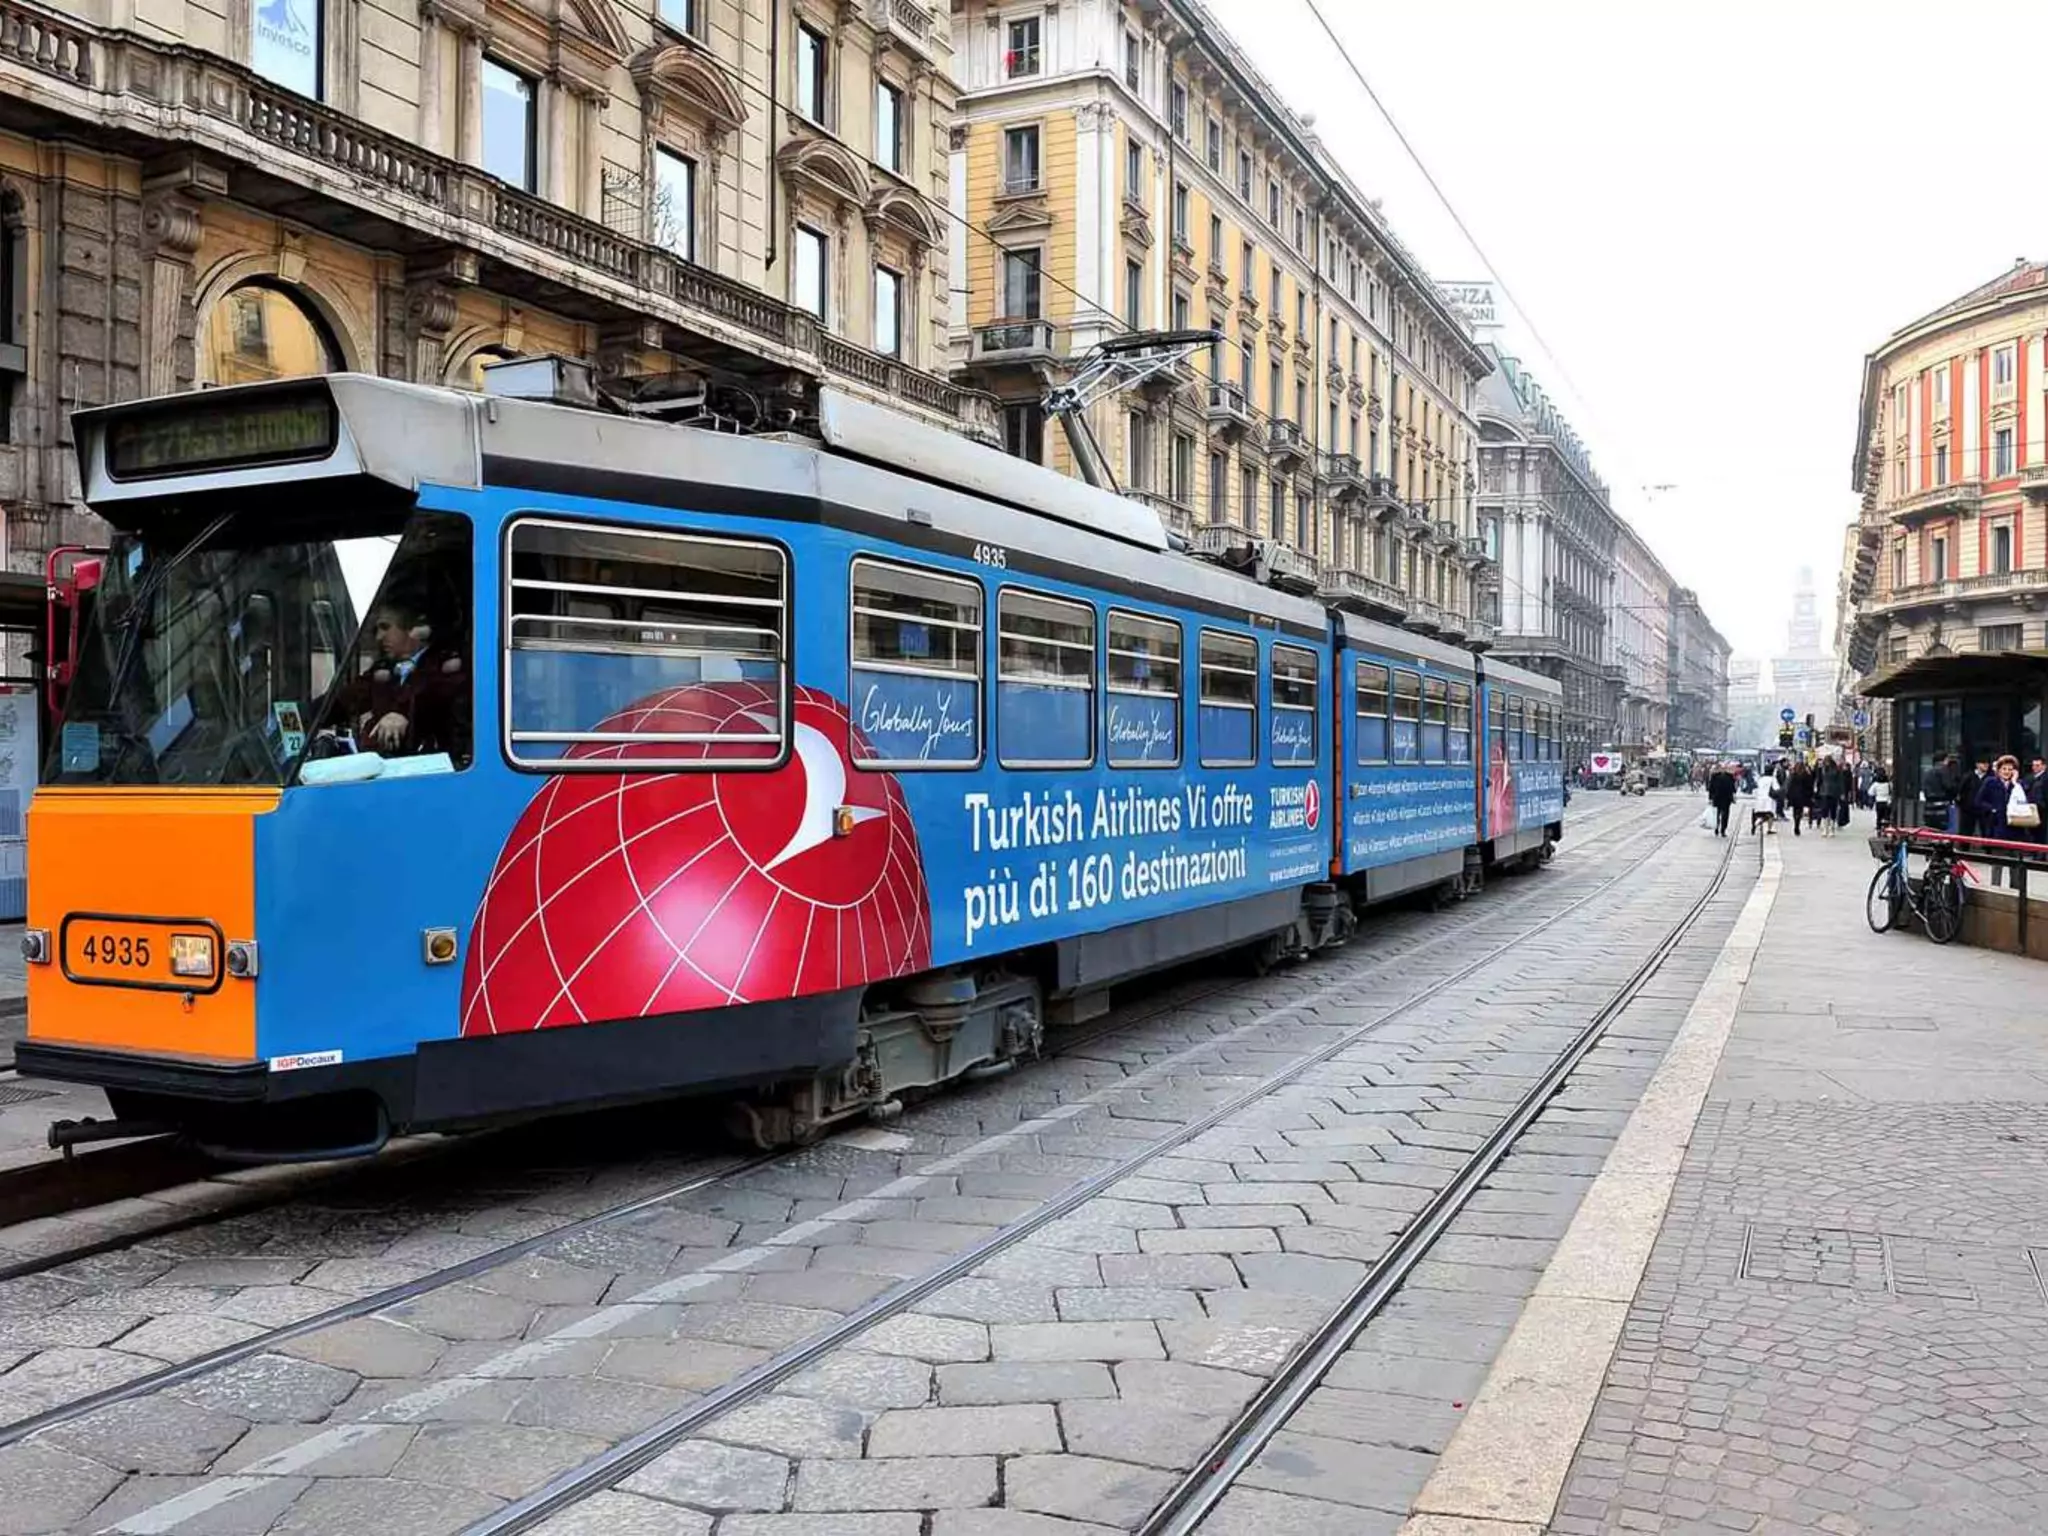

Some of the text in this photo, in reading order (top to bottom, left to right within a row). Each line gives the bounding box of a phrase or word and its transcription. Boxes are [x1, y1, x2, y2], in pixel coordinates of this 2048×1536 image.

[258, 21, 311, 56] Invesco
[973, 543, 1007, 570] 4935
[862, 684, 974, 760] Globally Yours
[1269, 787, 1305, 807] TURKISH
[964, 782, 1254, 852] Turkish Airlines Vi offre
[1269, 808, 1305, 830] AIRLINES
[964, 835, 1247, 947] più di 160 destinazioni
[83, 935, 151, 968] 4935
[276, 1055, 337, 1069] IGPDecaux
